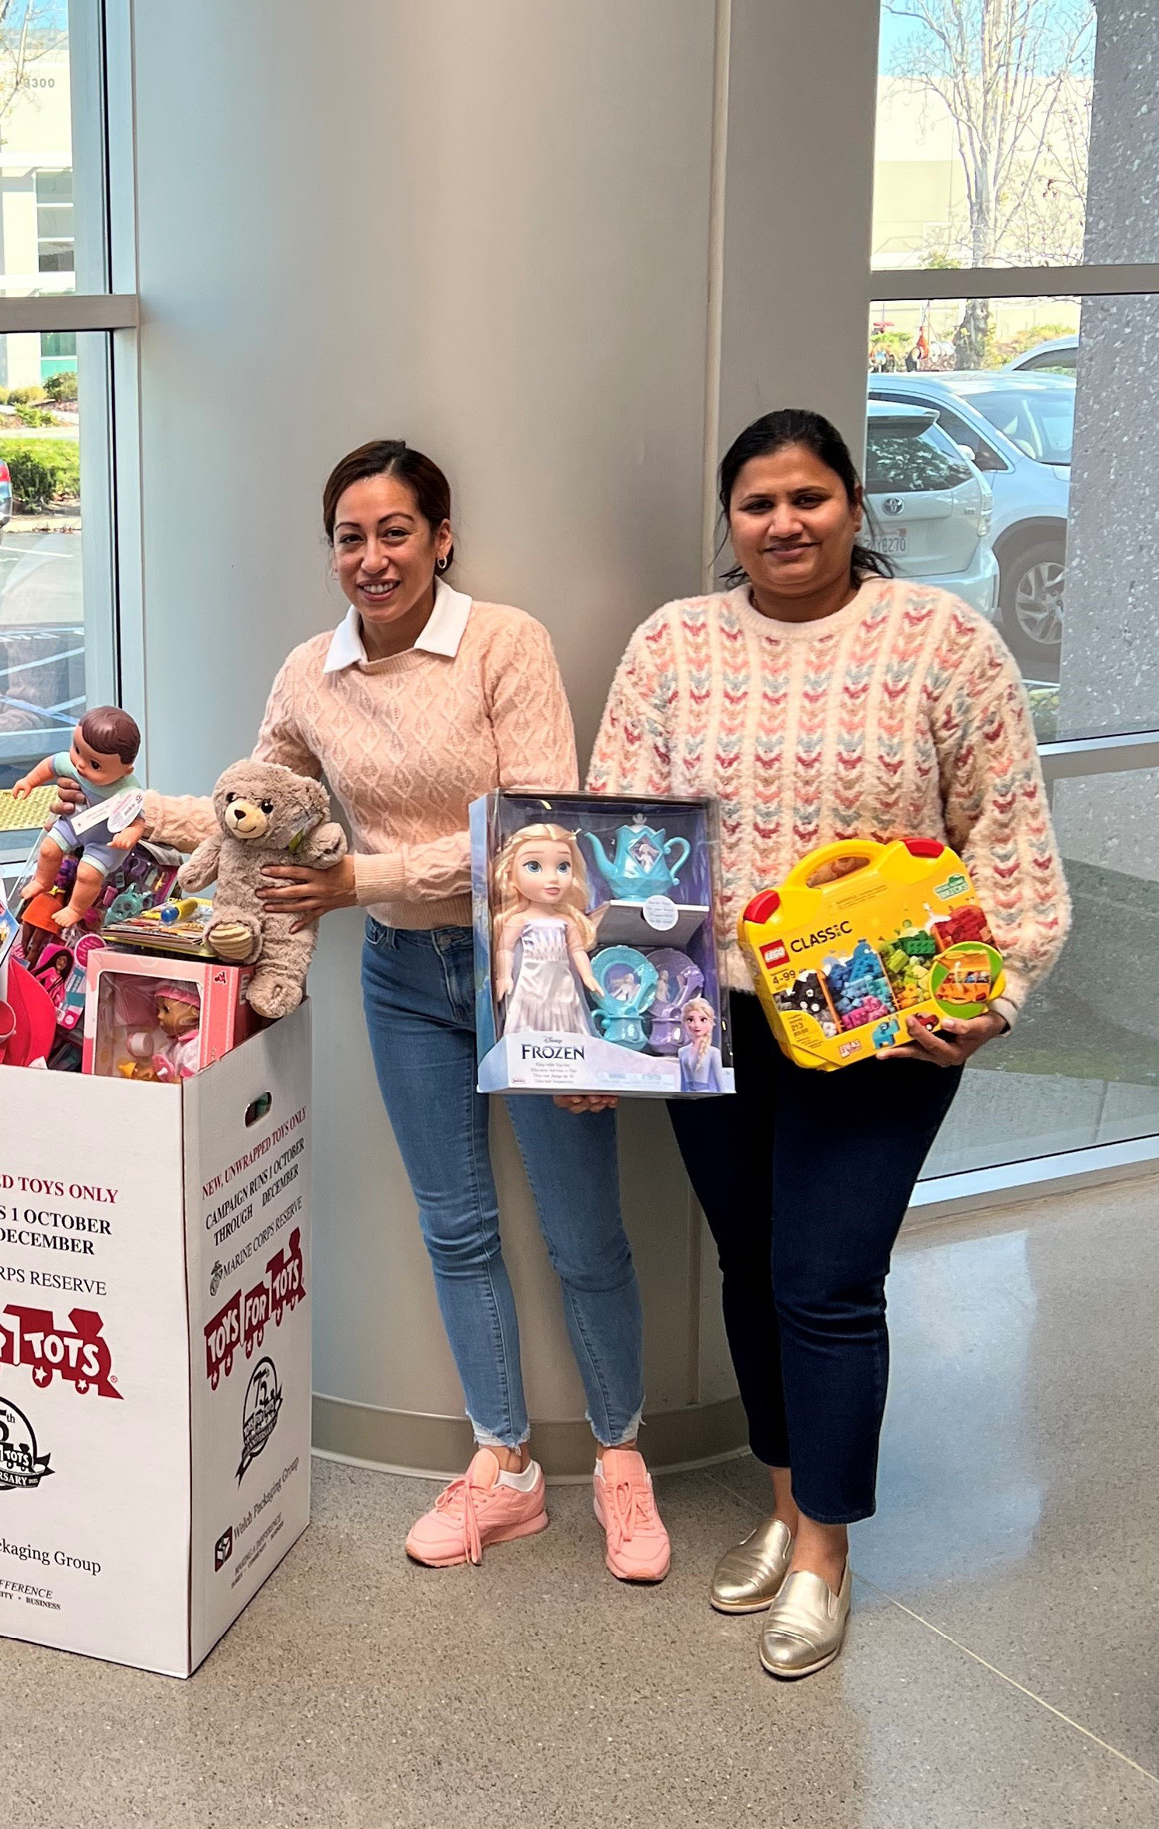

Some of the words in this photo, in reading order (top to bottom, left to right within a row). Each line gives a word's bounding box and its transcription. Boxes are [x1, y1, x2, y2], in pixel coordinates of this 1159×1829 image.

[773, 970, 796, 984] 4-99
[521, 1043, 585, 1061] FROZEN
[202, 1177, 224, 1200] NEW,
[224, 1139, 271, 1184] UNWRAPPED
[272, 1123, 289, 1147] TOYS
[290, 1106, 306, 1133] ONLY
[18, 1176, 64, 1197] TOYS
[69, 1183, 118, 1204] ONLY
[205, 1185, 249, 1230] CAMPAIGN
[249, 1170, 268, 1196] RUNS
[273, 1137, 305, 1174] OCTOBER
[213, 1204, 253, 1247] THROUGH
[262, 1163, 299, 1207] DECEMBER
[11, 1207, 18, 1222] 1
[23, 1209, 112, 1236] OCTOBER
[223, 1245, 252, 1279] MARINE
[253, 1225, 275, 1252] CORPS
[275, 1196, 303, 1231] RESERVE
[30, 1271, 107, 1296] RESERVE
[207, 1308, 239, 1363] TOYS
[245, 1294, 266, 1330] FOR
[273, 1258, 300, 1300] TOTS
[23, 1332, 101, 1377] TOTS
[4, 1450, 29, 1466] TOTS
[54, 1551, 101, 1576] Group
[25, 1596, 61, 1610] BUSINESS
